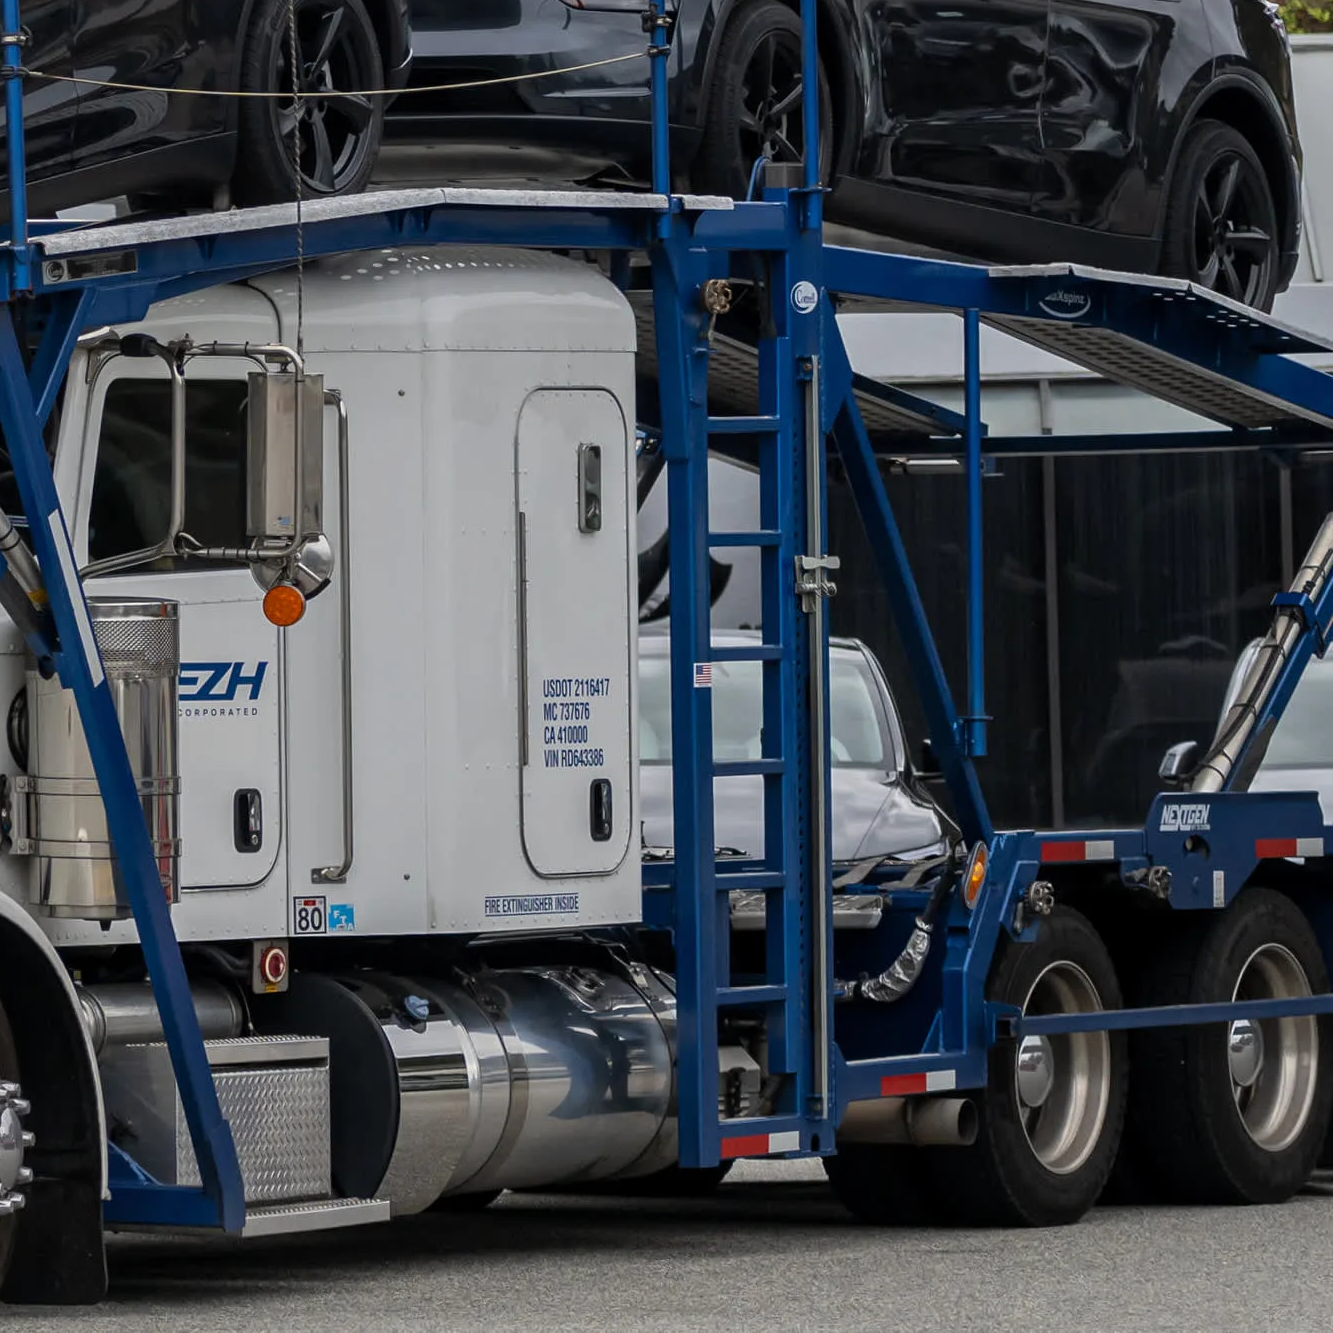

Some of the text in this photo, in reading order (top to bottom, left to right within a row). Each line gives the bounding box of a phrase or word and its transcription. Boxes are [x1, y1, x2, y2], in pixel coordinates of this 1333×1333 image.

[543, 678, 610, 698] USDOT 2116417
[178, 708, 258, 717] CORPORATED
[543, 702, 590, 721] MC 737676
[544, 725, 588, 744] CA 410000
[543, 749, 559, 767] VIN
[1160, 804, 1211, 827] NEXTGEN
[485, 895, 579, 914] FIRE EXTINGUISHER INSIDE
[298, 907, 322, 931] 80
